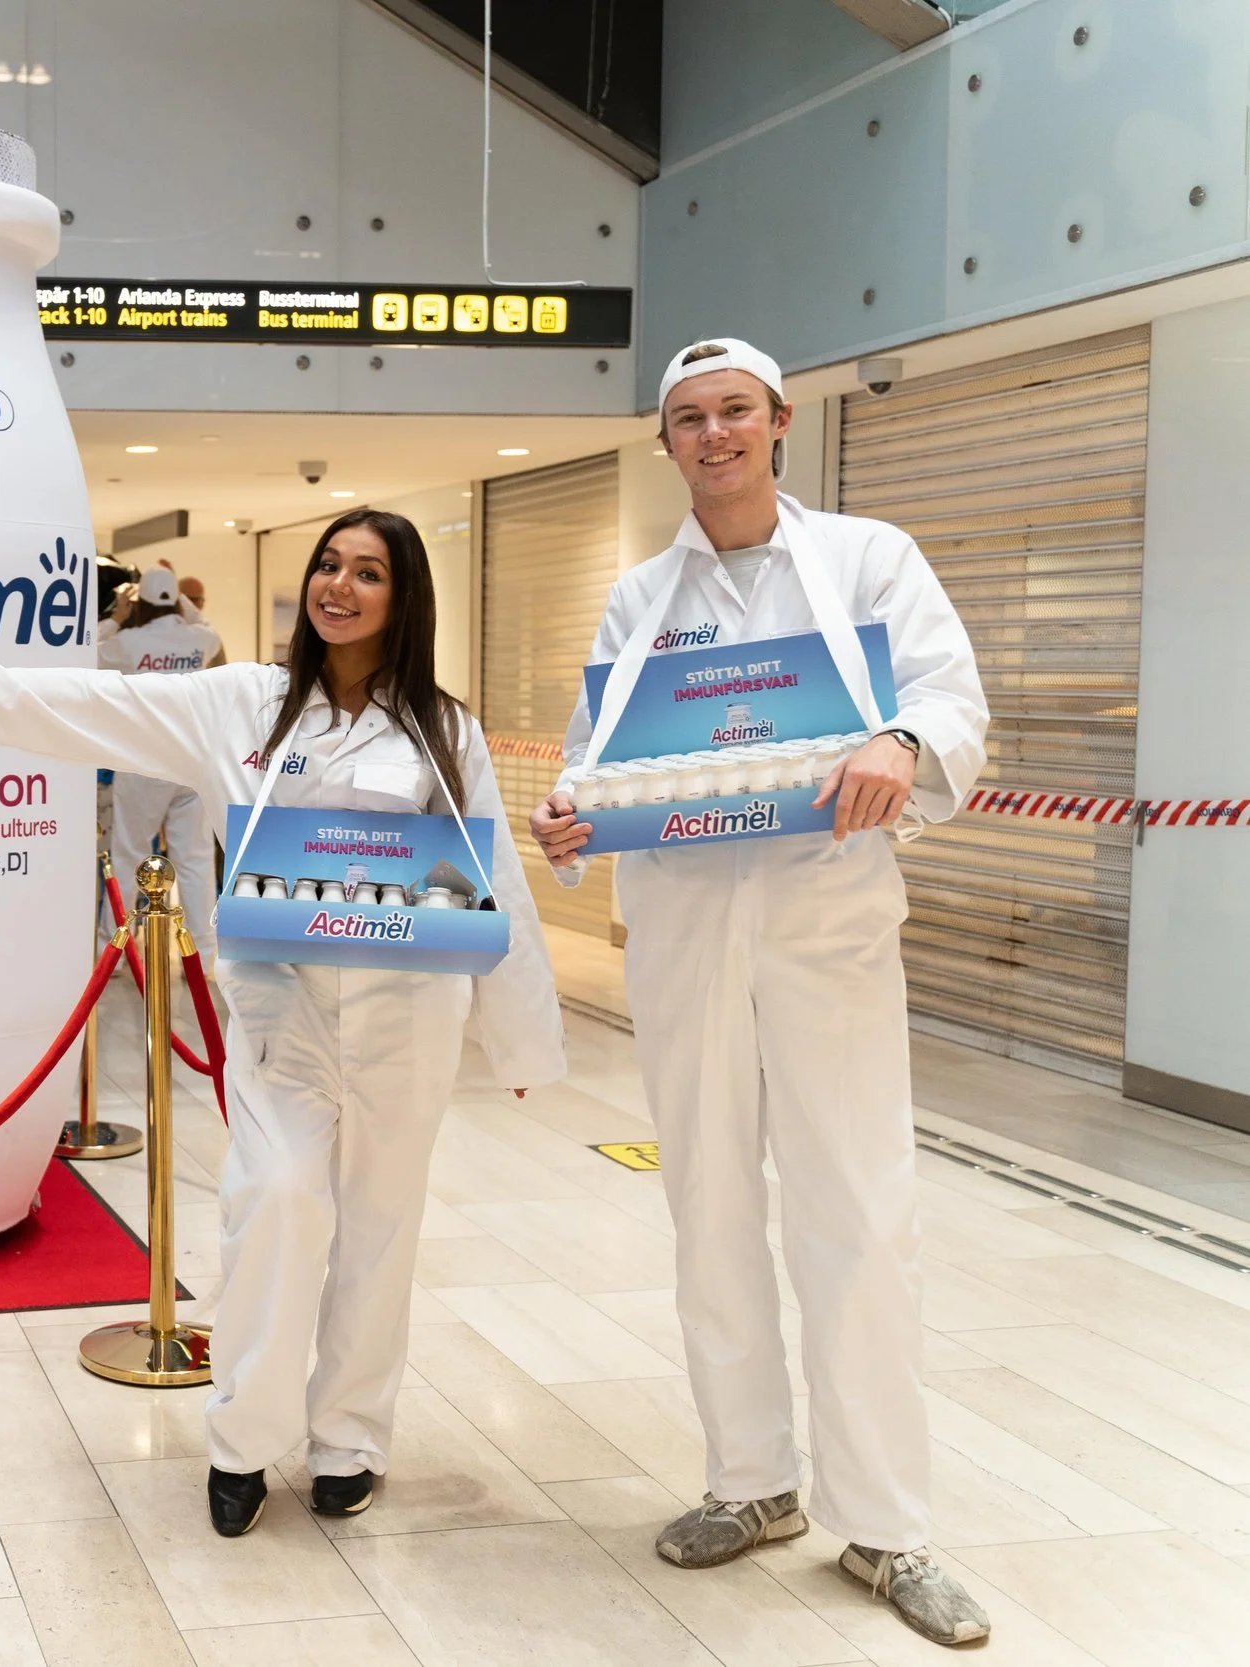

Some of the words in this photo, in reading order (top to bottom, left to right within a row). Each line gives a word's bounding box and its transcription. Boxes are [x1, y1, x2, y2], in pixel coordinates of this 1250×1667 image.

[73, 287, 105, 304] 1-10
[118, 288, 181, 305] Arlanda
[187, 290, 246, 310] Express
[258, 290, 360, 309] Bussterminal
[74, 307, 107, 325] 1-10
[118, 308, 178, 330] Airport
[181, 309, 228, 327] trains
[258, 310, 289, 328] Bus
[291, 310, 359, 329] terminal
[653, 623, 719, 650] ctimel
[137, 648, 204, 671] Actimel
[686, 667, 744, 685] STÖTTA
[747, 660, 781, 676] DITT
[674, 673, 799, 702] IMMUNFÖRSVAR!
[712, 720, 772, 744] Actimel
[242, 750, 307, 775] Aiel
[661, 800, 778, 839] Actimel
[317, 825, 367, 842] STÖTTA
[371, 830, 402, 843] DITT
[304, 841, 413, 859] IMMUNFÖRSVAR!
[307, 911, 412, 940] Actimel
